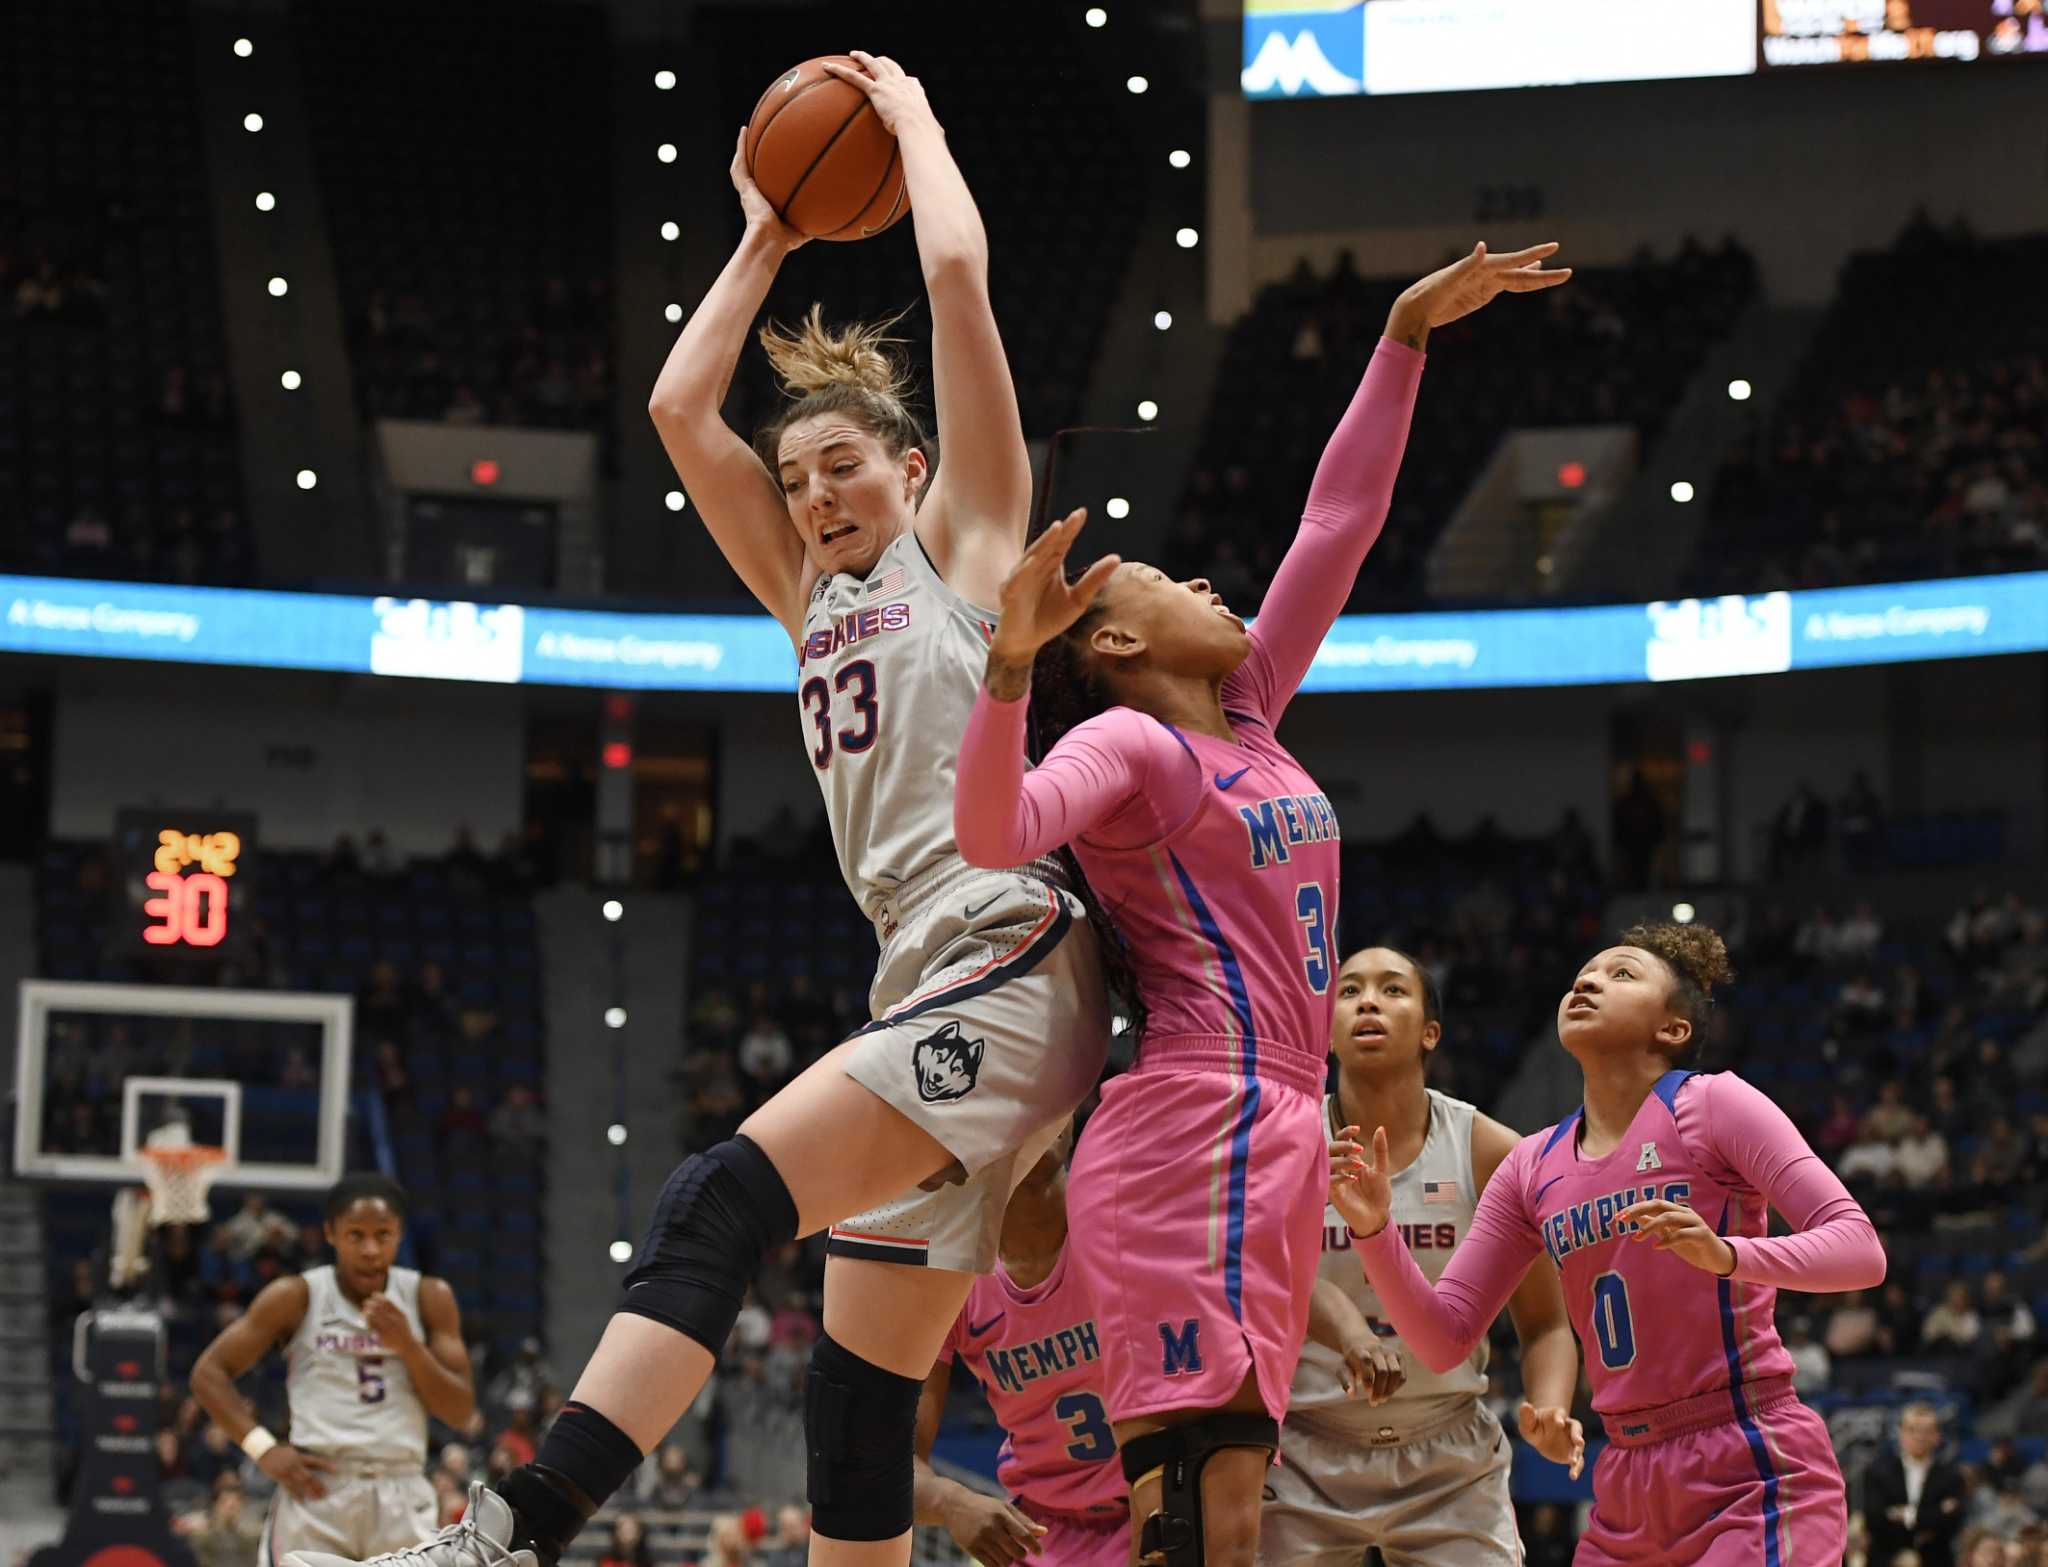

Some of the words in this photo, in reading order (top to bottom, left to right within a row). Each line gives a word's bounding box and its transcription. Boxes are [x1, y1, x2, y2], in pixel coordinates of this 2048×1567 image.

[800, 603, 910, 668] SKIES
[801, 659, 878, 770] 33
[143, 871, 229, 946] 30
[1157, 1317, 1206, 1379] M
[1591, 1268, 1637, 1372] 0
[356, 1353, 386, 1405] 5
[1055, 1391, 1119, 1463] 3
